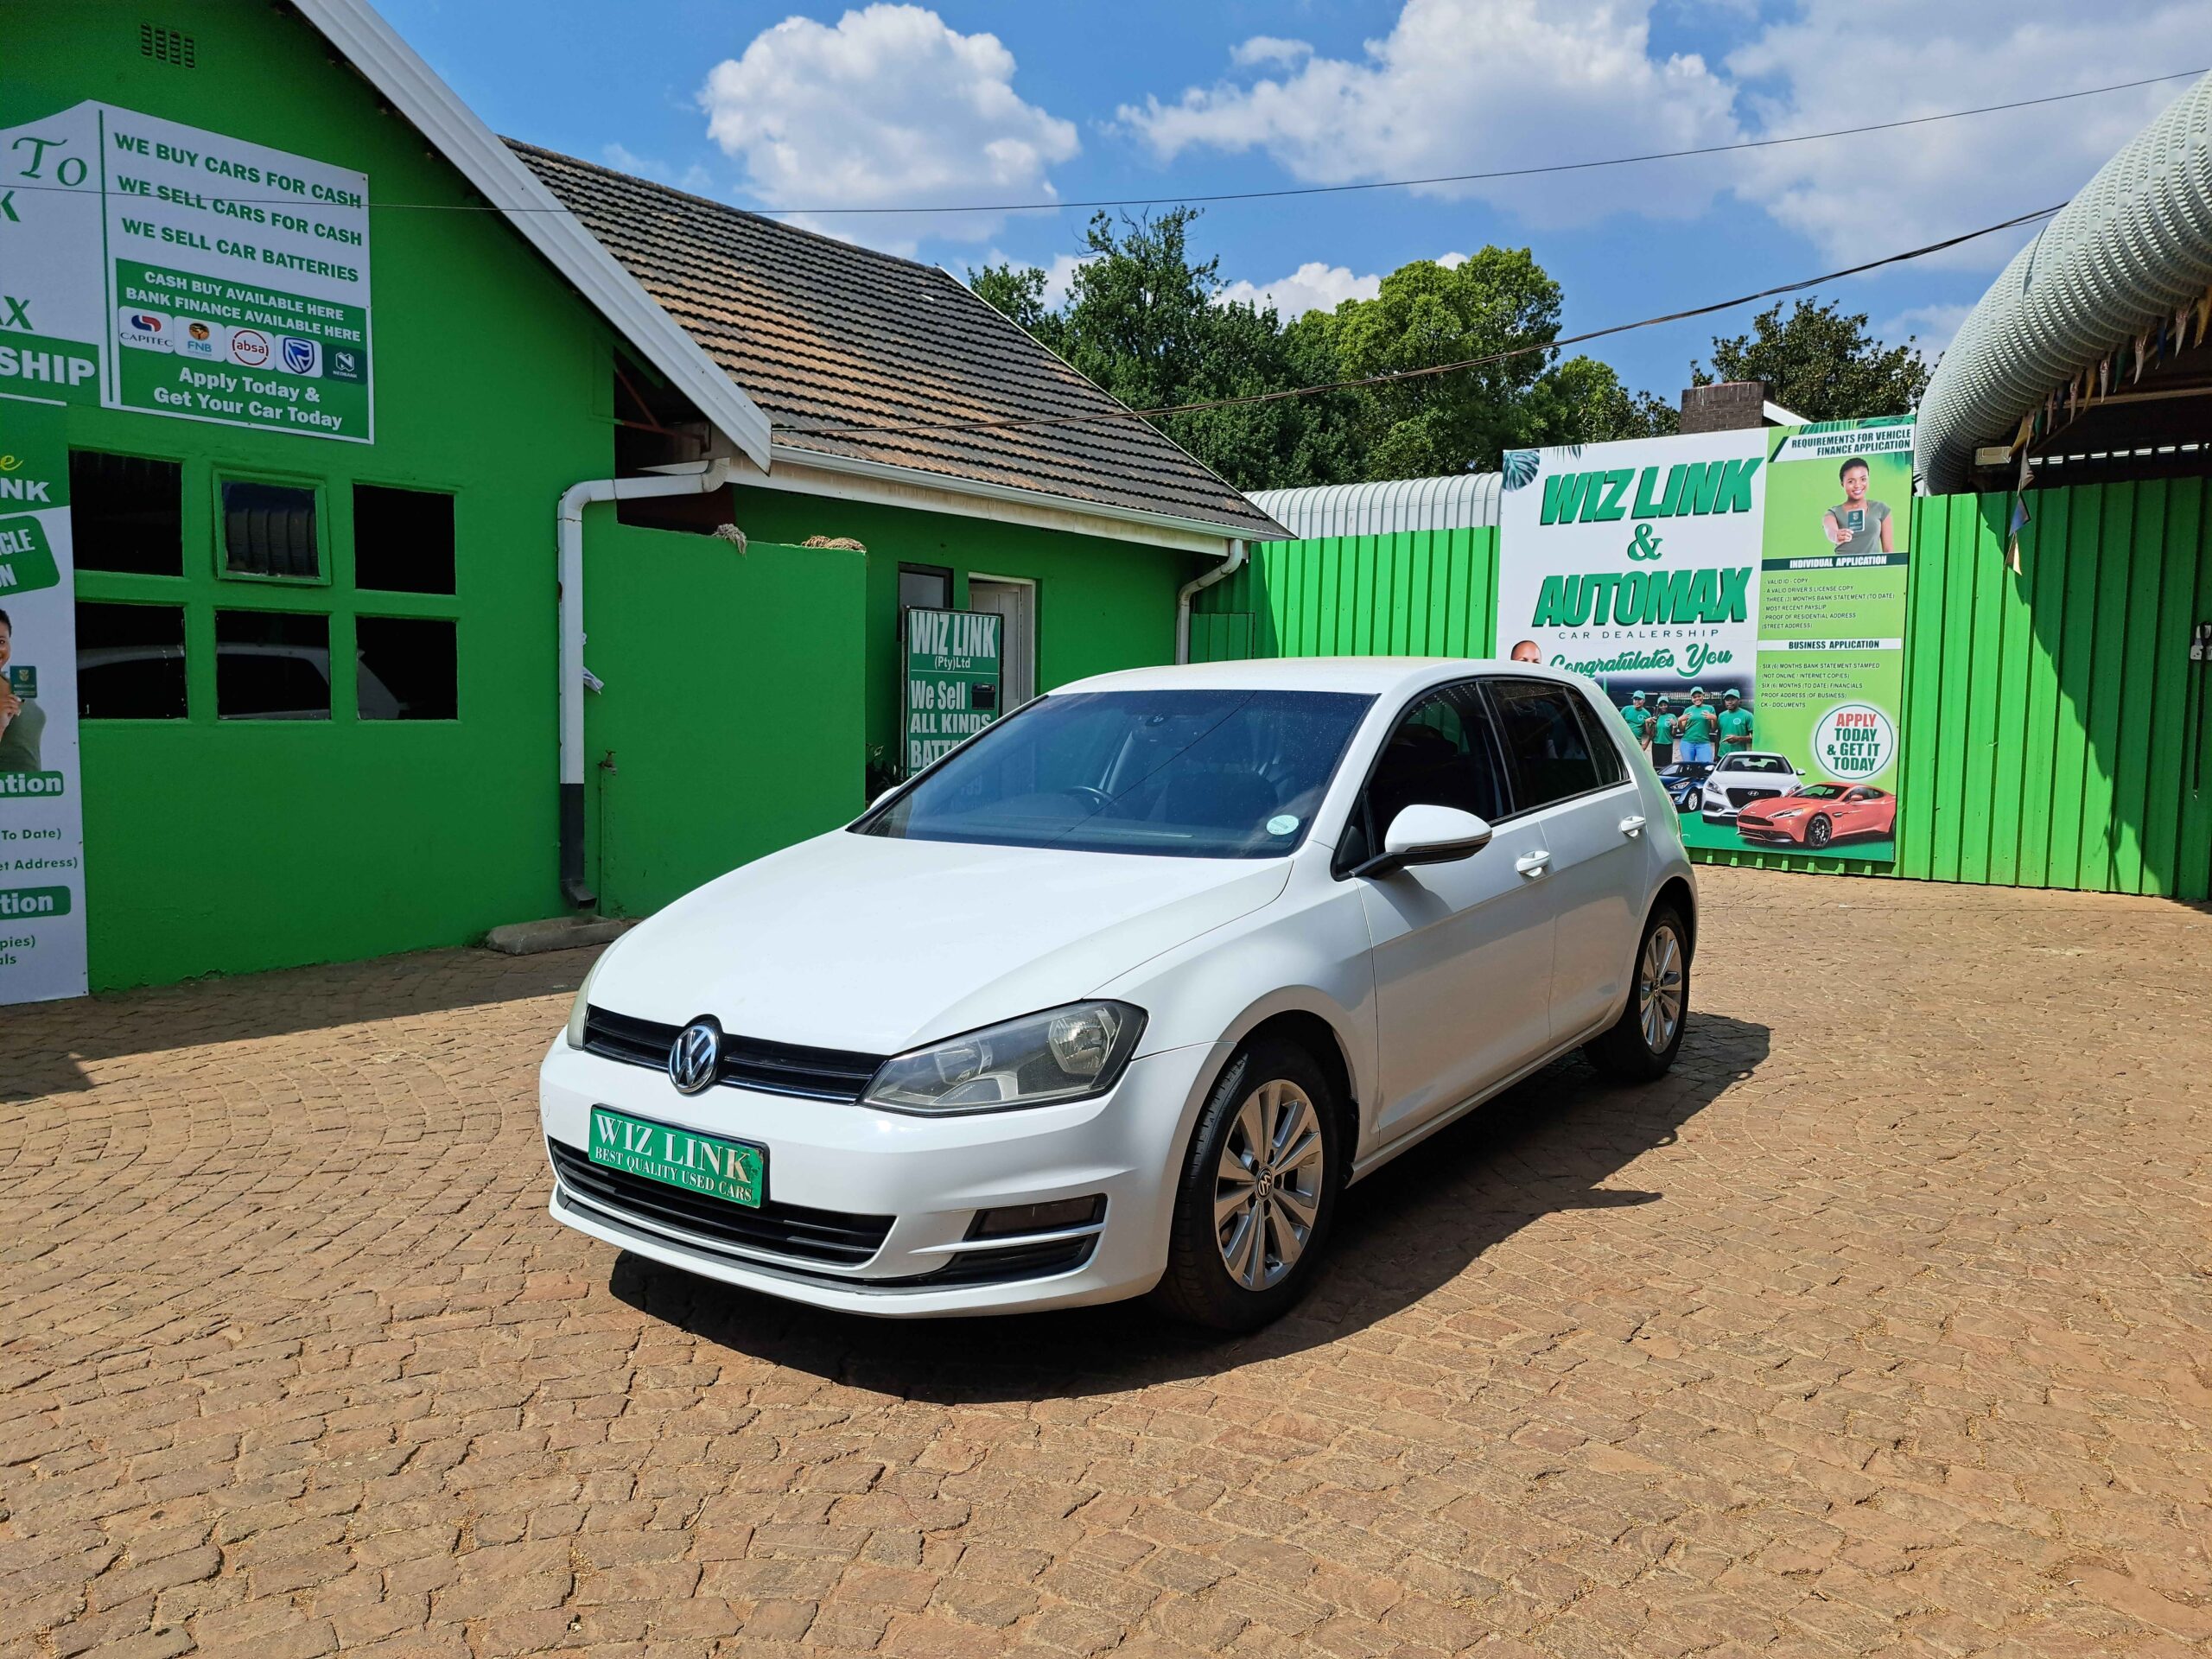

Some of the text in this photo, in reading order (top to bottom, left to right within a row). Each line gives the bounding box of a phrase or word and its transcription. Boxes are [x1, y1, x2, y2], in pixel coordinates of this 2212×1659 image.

[114, 132, 361, 209] WE BUY CARS FOR CASH
[118, 175, 361, 246] WE SELL CARS FOR CASH
[122, 218, 359, 283] WE SELL CAR BATTERIES
[144, 271, 344, 321] CASH BUY AVAILABLE HERE
[0, 296, 34, 332] X
[125, 287, 361, 341] BANK FINANCE AVAILABLE HERE
[120, 333, 174, 346] CAPITEC
[188, 340, 213, 353] FNB
[237, 340, 265, 354] absa
[179, 366, 321, 403] Apply Today &
[154, 387, 342, 430] Get Your Car Today
[1791, 429, 1911, 448] REQUIREMENTS FOR VEHICLE
[1817, 439, 1910, 456] FINANCE APPLICATION
[1540, 457, 1764, 525] WIZ LINK
[1627, 523, 1663, 562] &
[0, 563, 18, 588] N
[1789, 556, 1887, 569] INDIVIDUAL APPLICATION
[1531, 567, 1753, 628] AUTOMAX
[911, 611, 997, 658] WIZ LINK
[1558, 629, 1719, 640] CAR DEALERSHIP
[1789, 639, 1880, 649] BUSINESS APPLICATION
[934, 656, 971, 671] (Pty)Ltd
[1549, 642, 1732, 679] Congratulates You
[911, 679, 966, 710] We Sell
[910, 713, 992, 734] ALL KINDS
[1836, 713, 1877, 728] APPLY
[1834, 728, 1878, 742] TODAY
[910, 740, 963, 768] BATT
[1827, 742, 1881, 757] & GET IT
[1833, 757, 1876, 772] TODAY
[2, 828, 61, 840] To Date)
[15, 857, 78, 870] Address)
[594, 1113, 752, 1184] WIZ LINK
[595, 1147, 753, 1203] BEST QUALITY USED CARS
